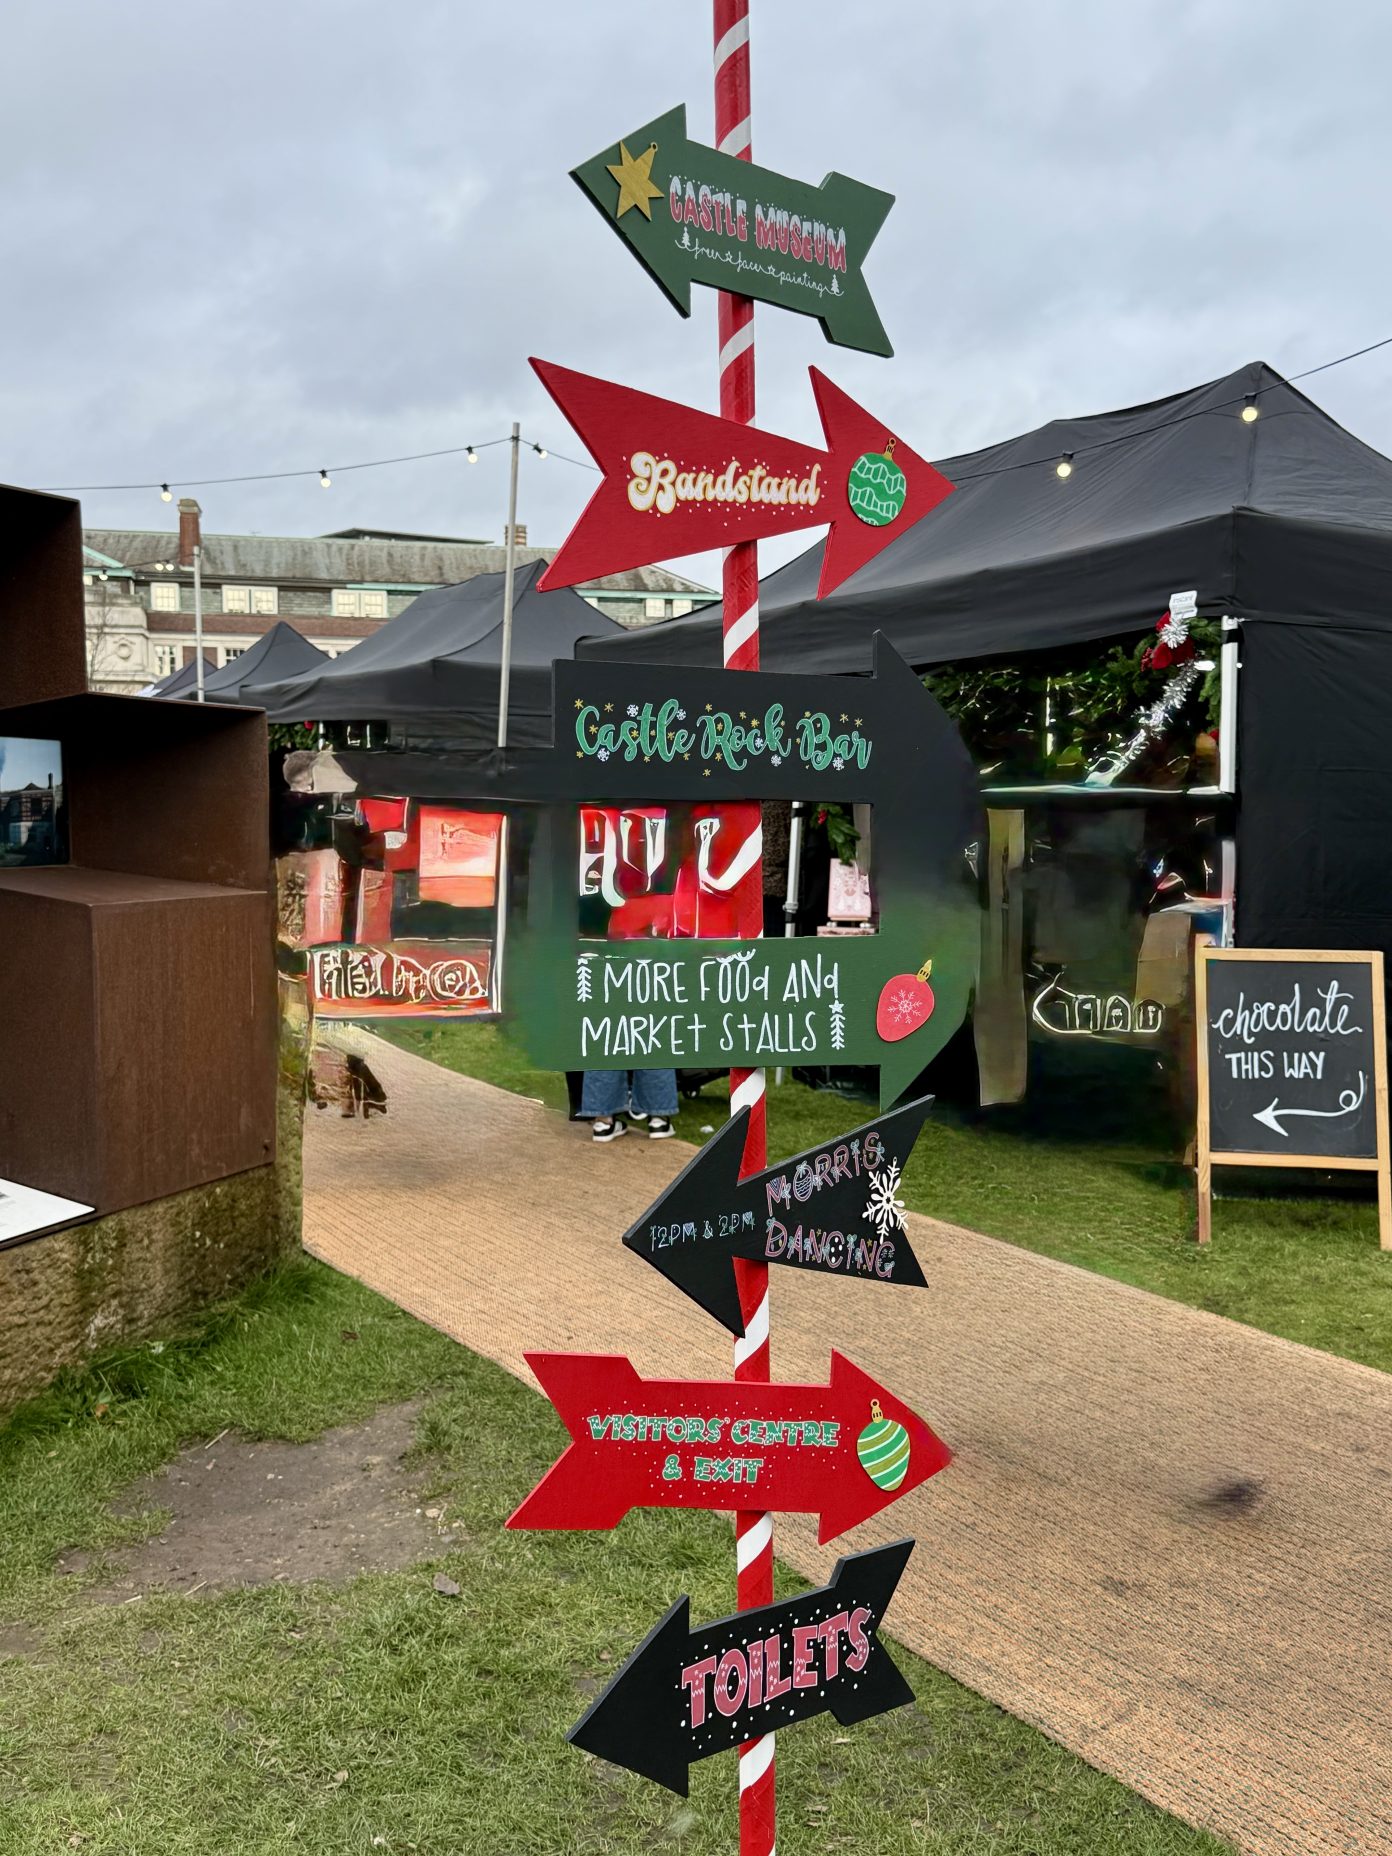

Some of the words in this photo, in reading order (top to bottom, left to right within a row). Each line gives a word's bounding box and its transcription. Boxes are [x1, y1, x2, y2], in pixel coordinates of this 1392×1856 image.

[669, 175, 748, 242] CASTLE
[755, 203, 847, 273] MUSEUM
[779, 272, 826, 299] painting
[627, 451, 822, 514] Bandstand
[575, 698, 695, 763] Castle
[697, 703, 792, 771] Rock
[796, 712, 873, 771] Bar
[603, 959, 687, 1004] MORE
[1211, 980, 1363, 1044] chocolate
[1225, 1050, 1275, 1080] THIS
[1283, 1051, 1326, 1080] WAY
[765, 1132, 883, 1216] MORRIS
[650, 1221, 698, 1252] 12PM
[702, 1220, 714, 1240] &
[718, 1210, 756, 1238] 2PM
[765, 1218, 897, 1278] DANCING
[731, 1419, 840, 1447] CENTRE
[662, 1454, 682, 1480] &
[694, 1456, 763, 1483] EXIT
[681, 1606, 871, 1729] TOILETS
